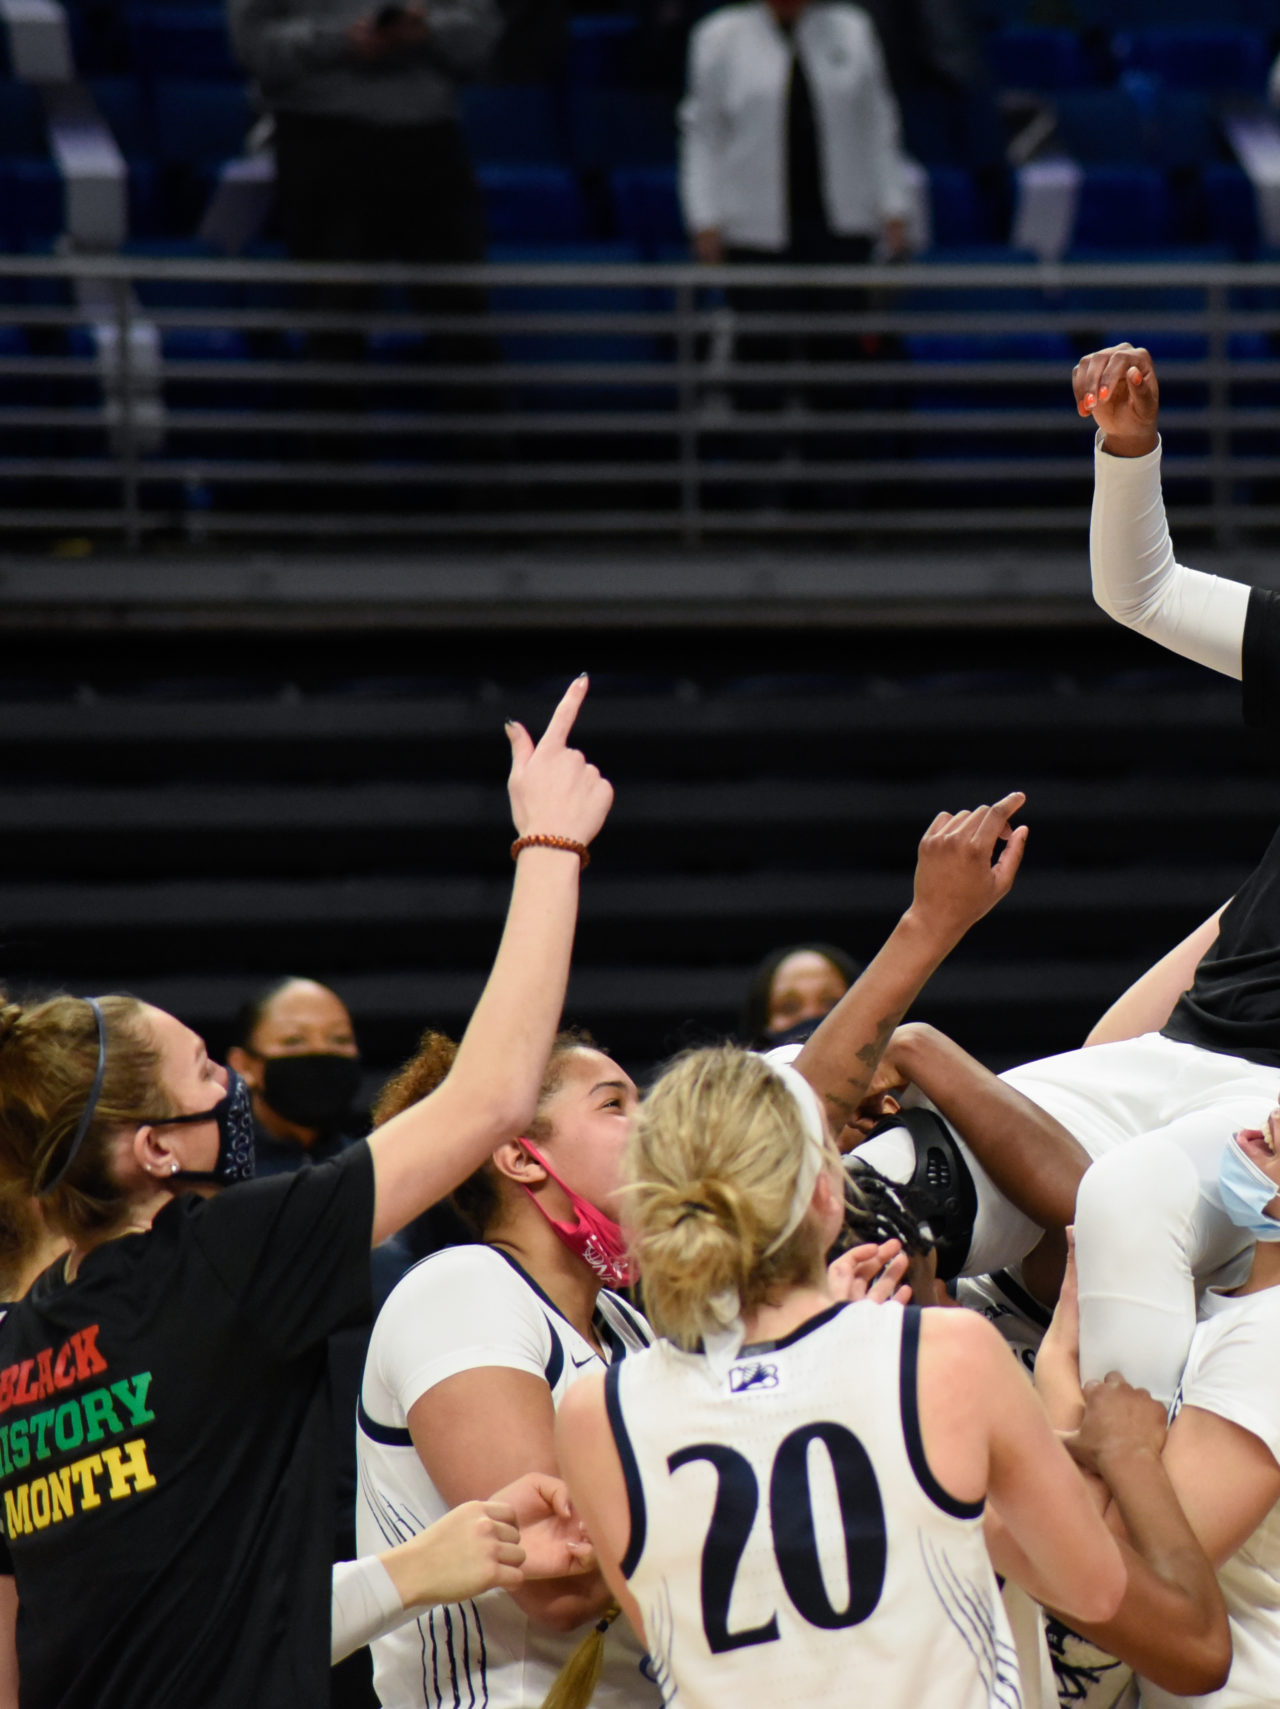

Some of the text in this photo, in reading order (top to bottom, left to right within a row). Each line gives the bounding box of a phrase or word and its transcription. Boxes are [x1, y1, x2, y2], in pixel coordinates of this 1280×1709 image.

[0, 1324, 108, 1415] BLACK
[0, 1371, 155, 1478] ISTORY
[4, 1438, 157, 1540] MONTH
[666, 1421, 888, 1655] 20
